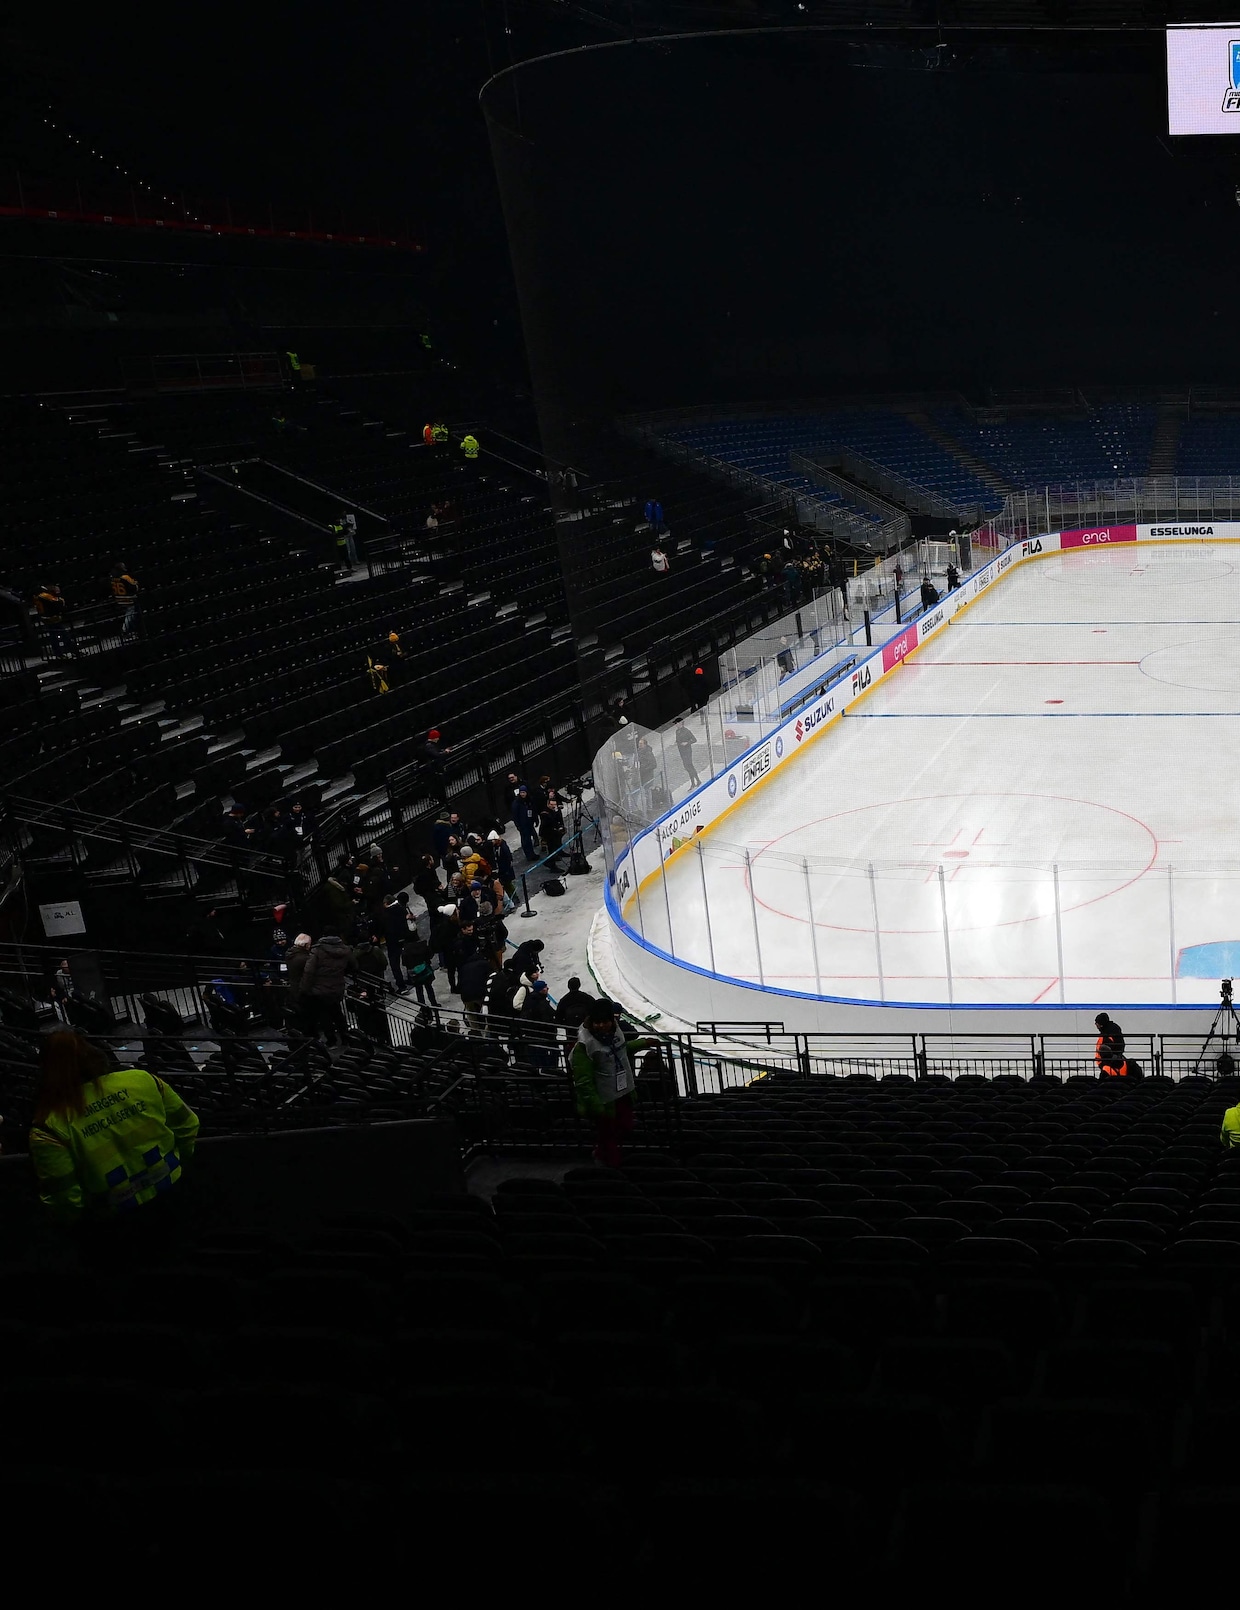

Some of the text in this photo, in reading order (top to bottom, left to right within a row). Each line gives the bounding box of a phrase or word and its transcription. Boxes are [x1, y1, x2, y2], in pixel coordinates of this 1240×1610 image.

[1082, 529, 1111, 544] enel
[1150, 526, 1213, 536] ESSELUNGA
[1022, 539, 1043, 557] FILA
[922, 609, 944, 635] ESSELUNGA
[893, 635, 907, 661] enel
[852, 665, 872, 696] FILA
[804, 697, 835, 732] SUZUKI
[743, 753, 770, 786] FINALS
[661, 801, 702, 842] ALTO ADIGE
[81, 1101, 147, 1139] MEDICAL SERVICE
